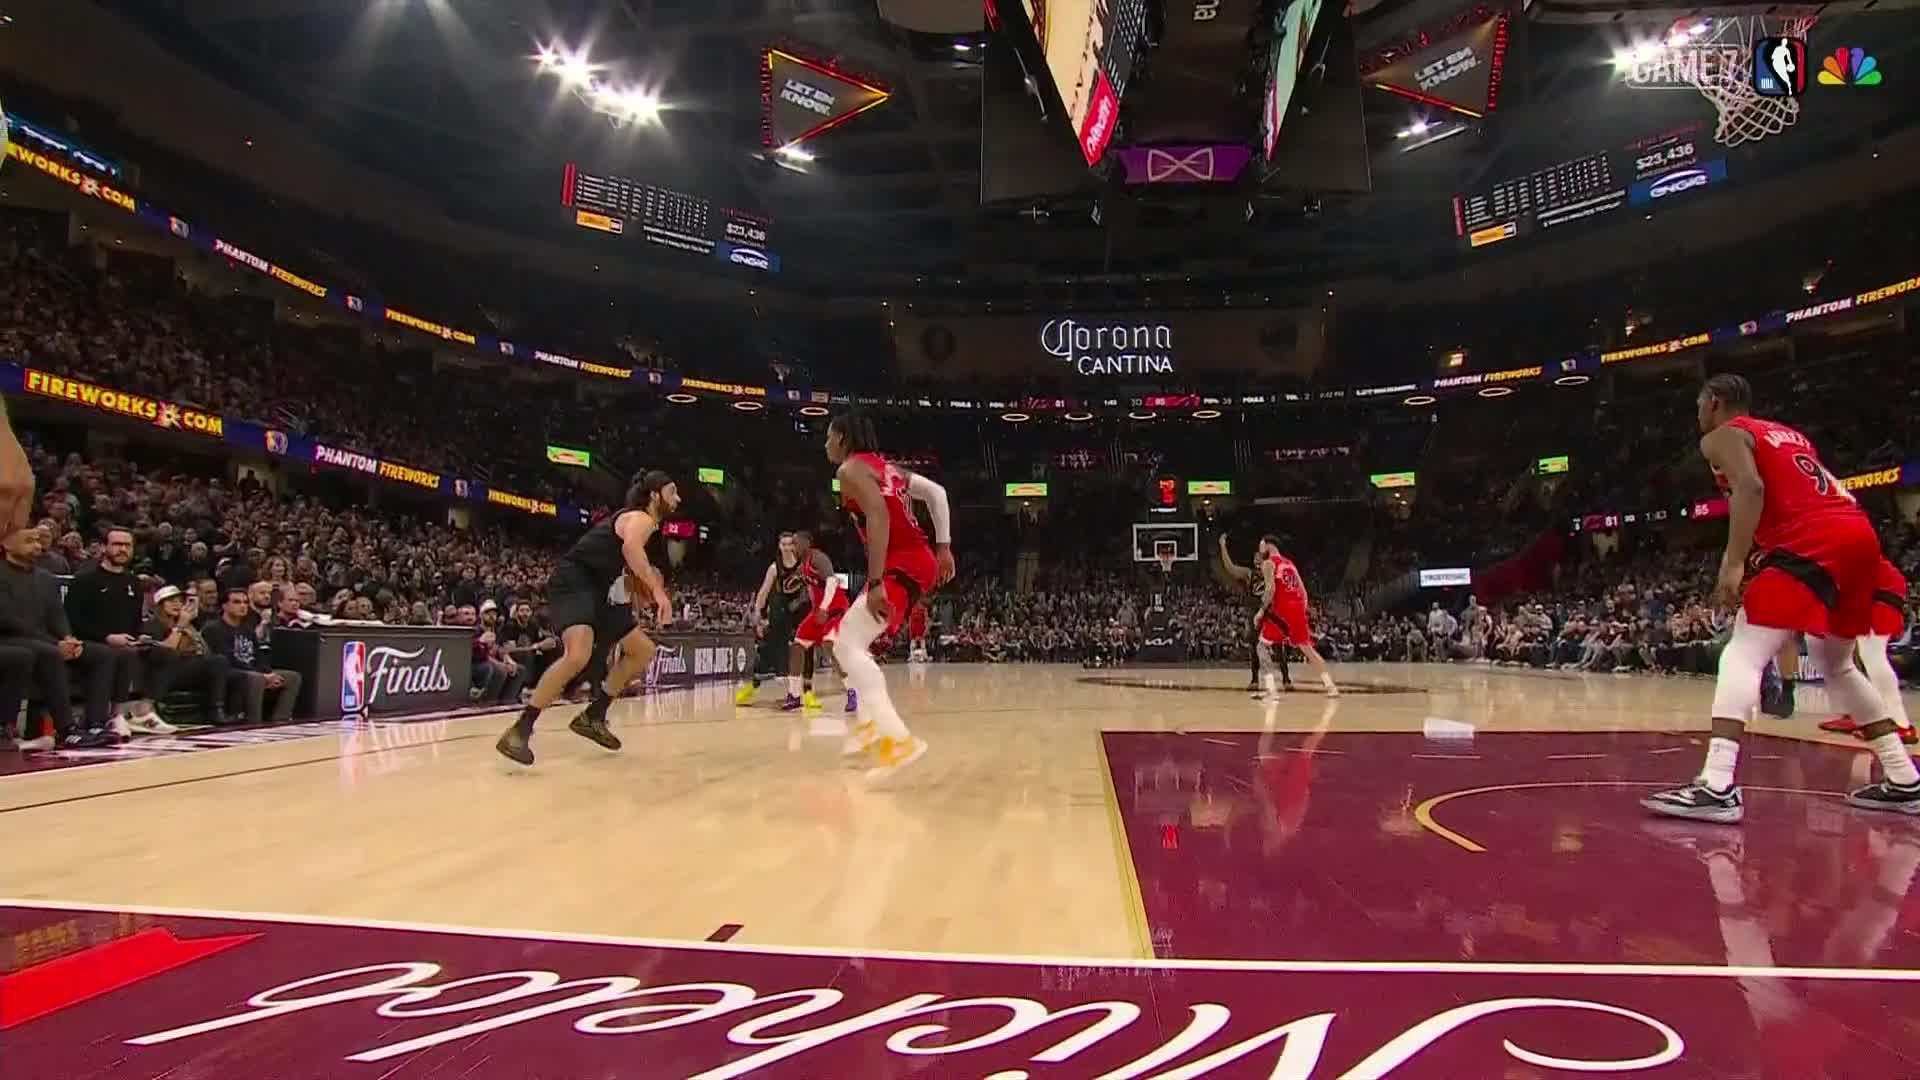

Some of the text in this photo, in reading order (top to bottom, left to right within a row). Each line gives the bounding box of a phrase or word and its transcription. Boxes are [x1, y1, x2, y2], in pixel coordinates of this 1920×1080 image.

[1635, 144, 1695, 171] $23,436
[214, 239, 327, 298] PHANTOM FIREWORKS
[1785, 297, 1852, 323] PHANTOM
[1041, 319, 1172, 361] Corona
[1600, 342, 1668, 364] FIREWORKS
[1077, 355, 1174, 375] CANTINA
[29, 370, 157, 420] FIREWORKS
[315, 443, 441, 489] PHANTOM FIREWORKS
[1792, 452, 1828, 497] 9
[367, 646, 451, 704] Finals
